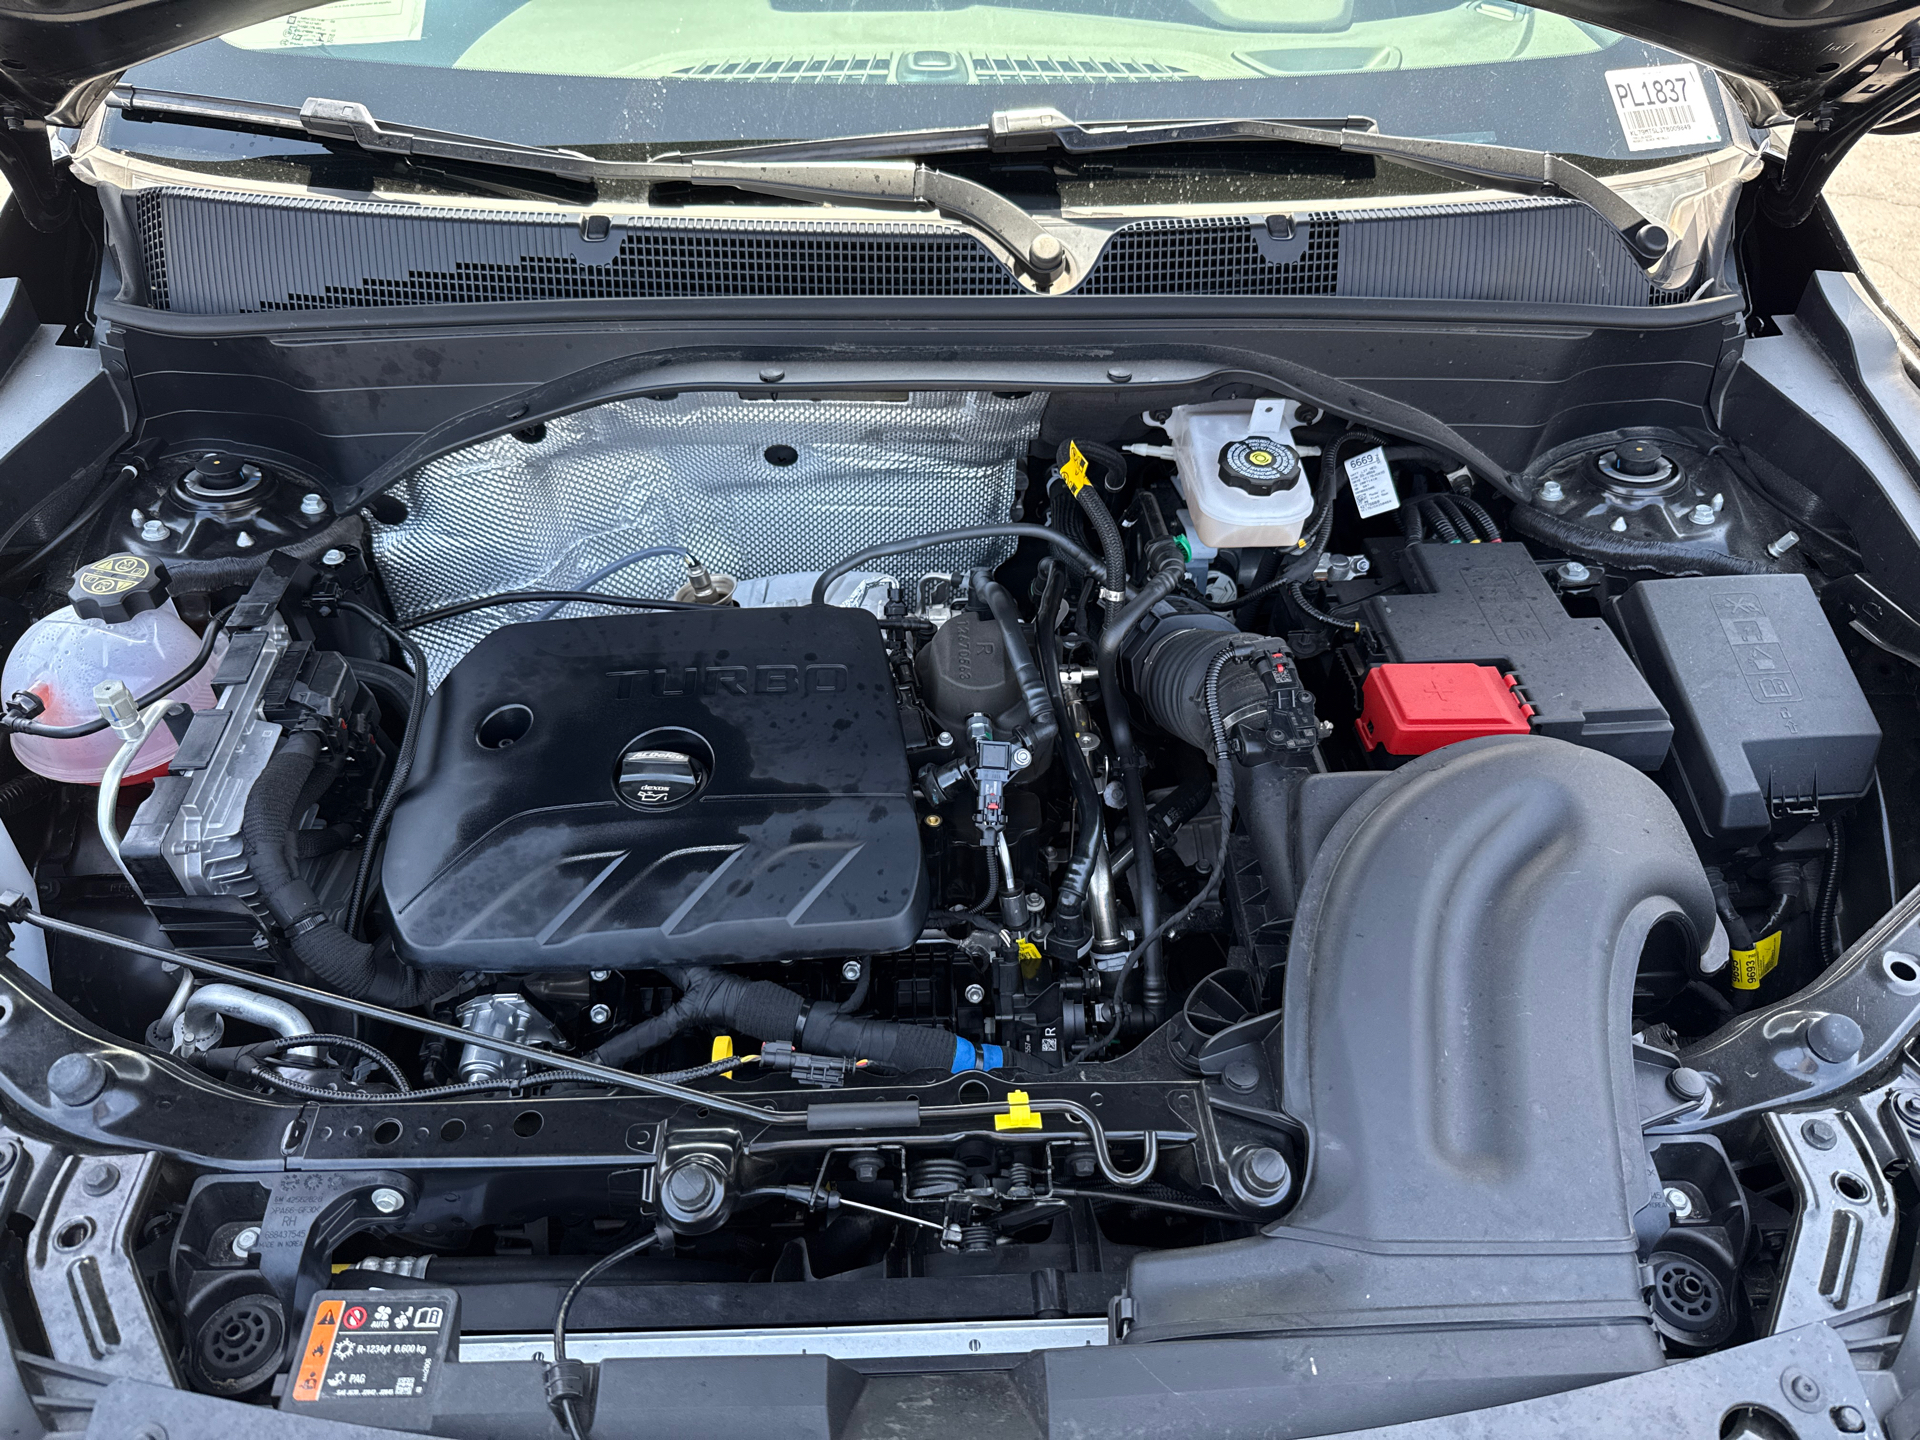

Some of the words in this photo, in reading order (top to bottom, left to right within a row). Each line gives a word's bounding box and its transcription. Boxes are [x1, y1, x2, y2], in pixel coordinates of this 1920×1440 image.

[1615, 77, 1688, 108] PL1837
[1350, 454, 1374, 469] 6669
[605, 662, 849, 702] TURBO
[629, 750, 686, 761] ACDelco
[1746, 960, 1757, 984] 9693
[1044, 1027, 1056, 1036] R
[281, 1215, 298, 1227] RH
[285, 1240, 303, 1248] KOREA
[370, 1320, 390, 1329] AUTO
[356, 1344, 392, 1356] R-1234yf
[393, 1344, 416, 1354] 0.600
[416, 1344, 427, 1355] kg
[348, 1373, 367, 1384] PAG
